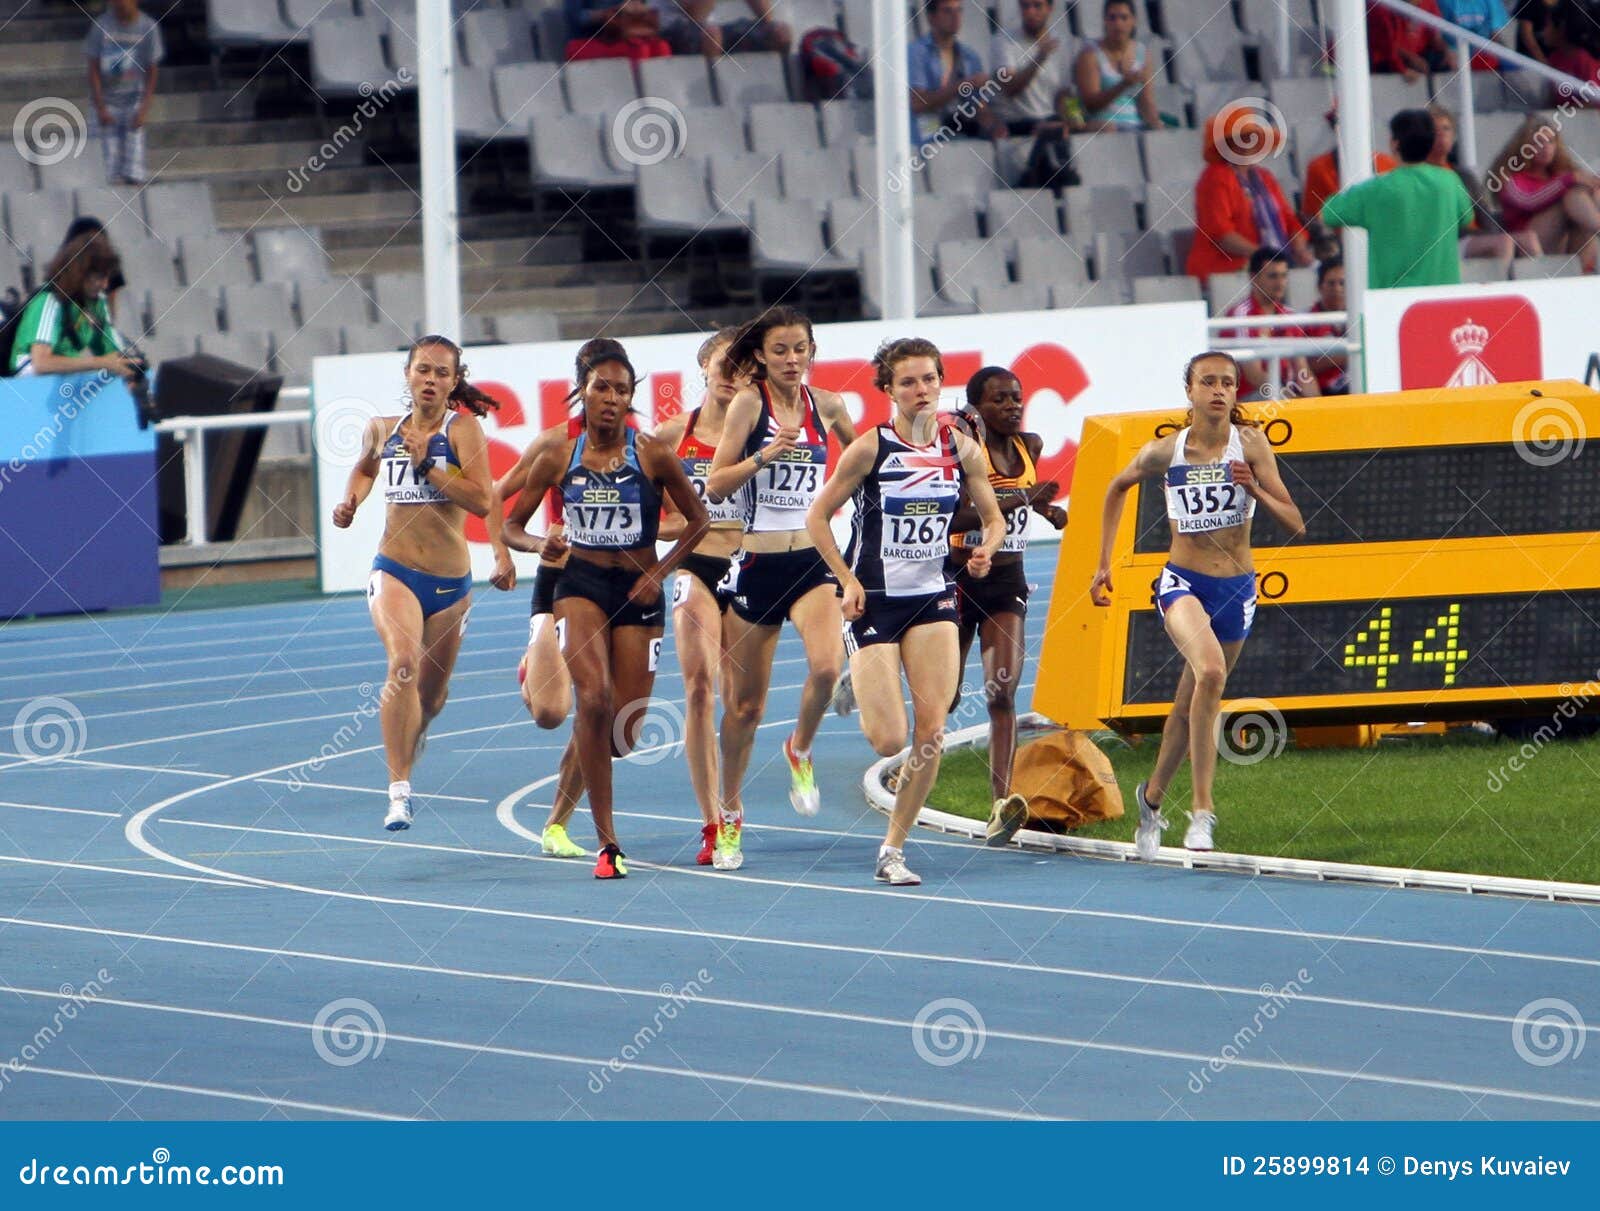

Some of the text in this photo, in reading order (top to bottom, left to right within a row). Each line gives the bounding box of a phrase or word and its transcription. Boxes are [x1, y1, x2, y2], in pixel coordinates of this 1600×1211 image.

[387, 460, 430, 486] 171
[766, 463, 818, 493] 1273
[758, 494, 804, 507] BARCELONA
[1177, 484, 1237, 515] 1352
[573, 505, 633, 530] 1773
[1180, 518, 1223, 530] BACELONA
[574, 530, 619, 545] BARCELONA
[890, 516, 948, 545] 1262
[883, 546, 932, 560] BARCELONA
[1344, 603, 1469, 689] 44
